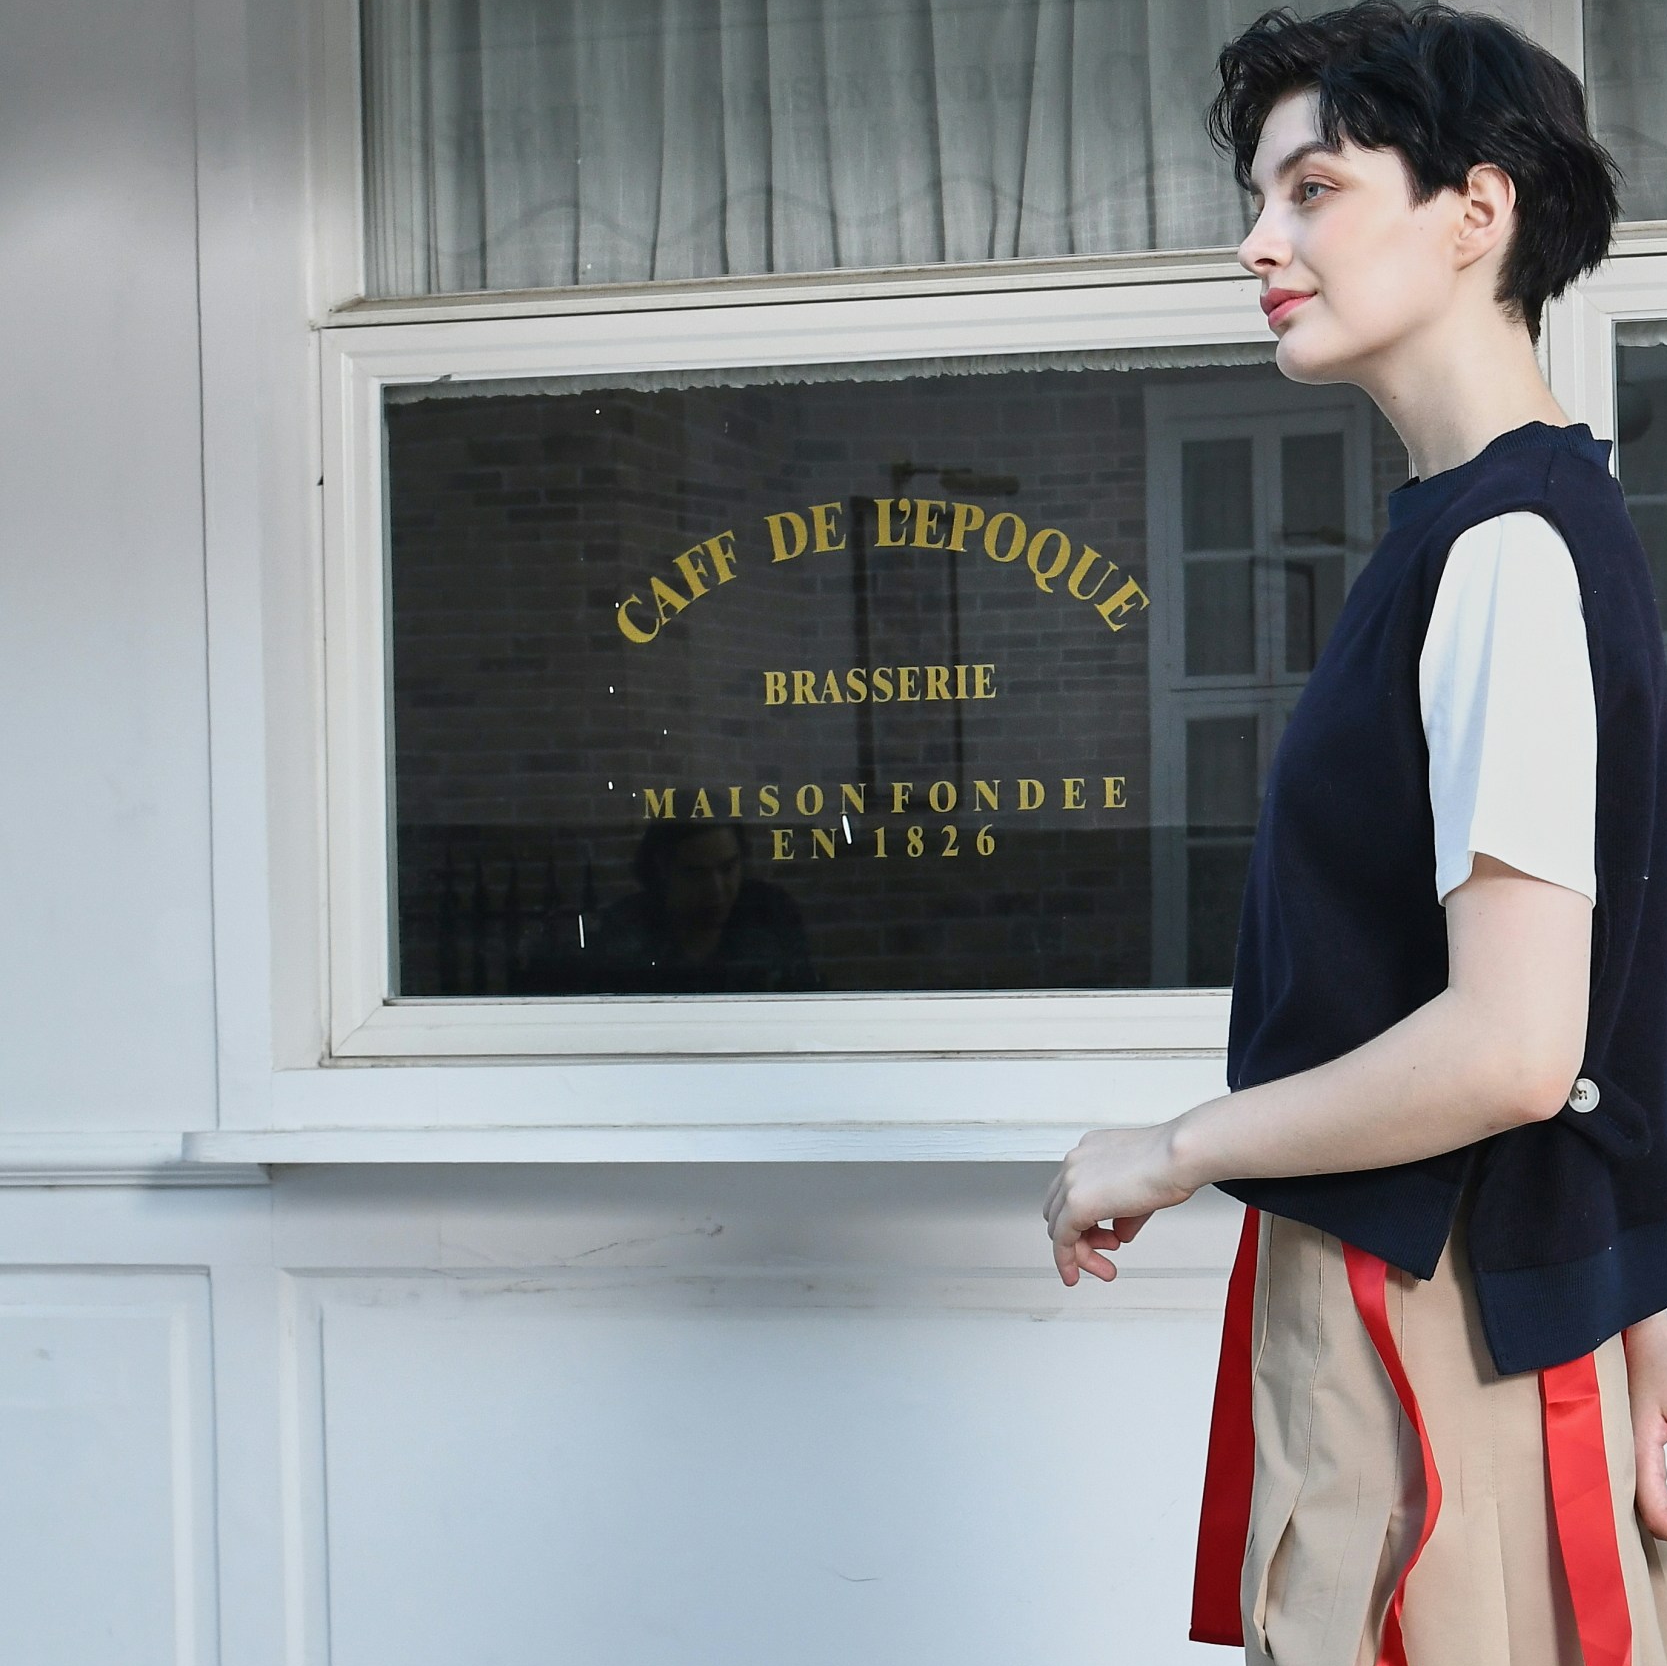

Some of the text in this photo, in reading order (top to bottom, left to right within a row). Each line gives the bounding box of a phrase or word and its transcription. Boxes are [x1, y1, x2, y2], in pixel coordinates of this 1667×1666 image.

[617, 498, 1150, 644] CAFF DE L'EPOQUE
[764, 664, 997, 706] BRASSERIE
[643, 777, 1127, 819] MAISON FONDEE
[772, 824, 996, 860] EN 1826
